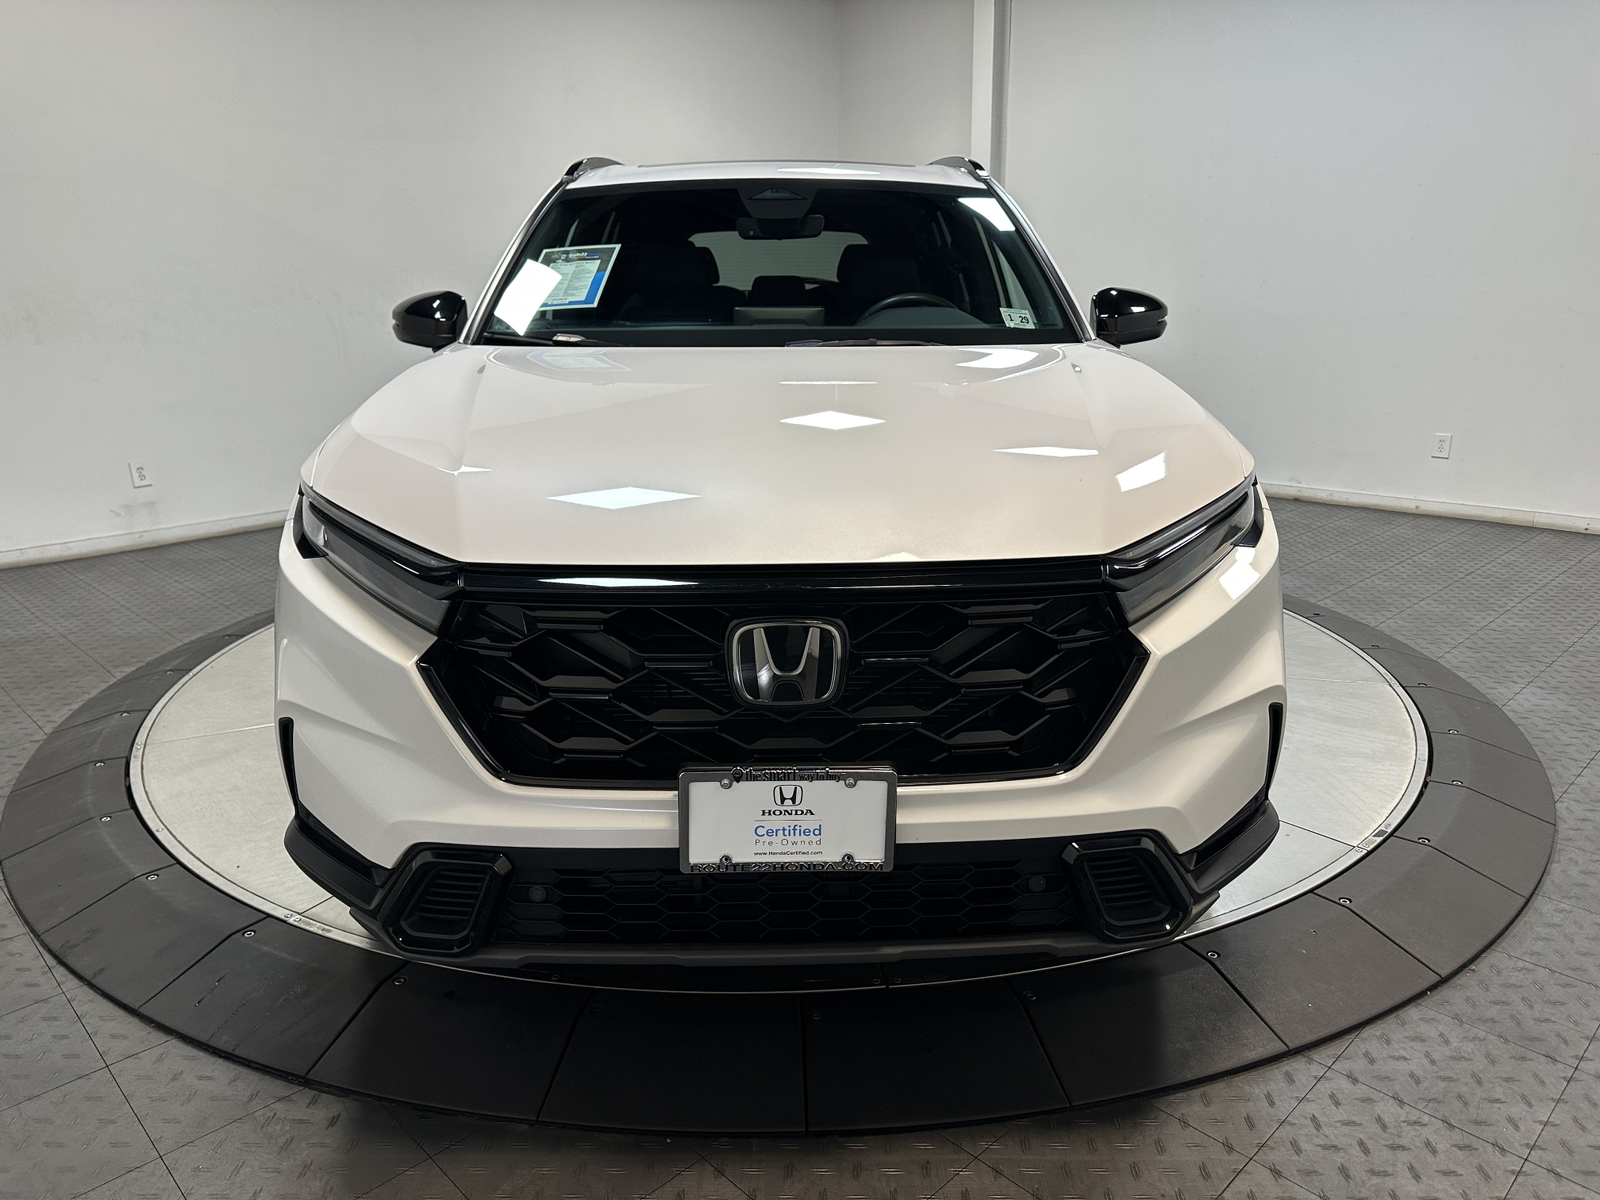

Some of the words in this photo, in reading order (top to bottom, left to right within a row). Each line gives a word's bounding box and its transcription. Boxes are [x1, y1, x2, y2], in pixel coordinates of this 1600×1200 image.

[1018, 315, 1030, 324] 29
[745, 768, 761, 782] the
[763, 766, 798, 782] smart
[799, 773, 815, 783] way
[816, 771, 825, 782] to
[826, 768, 843, 783] buy
[754, 824, 822, 837] Certified
[754, 838, 822, 847] Pre-Owned
[690, 862, 884, 873] ROUTE22HONDA.COM
